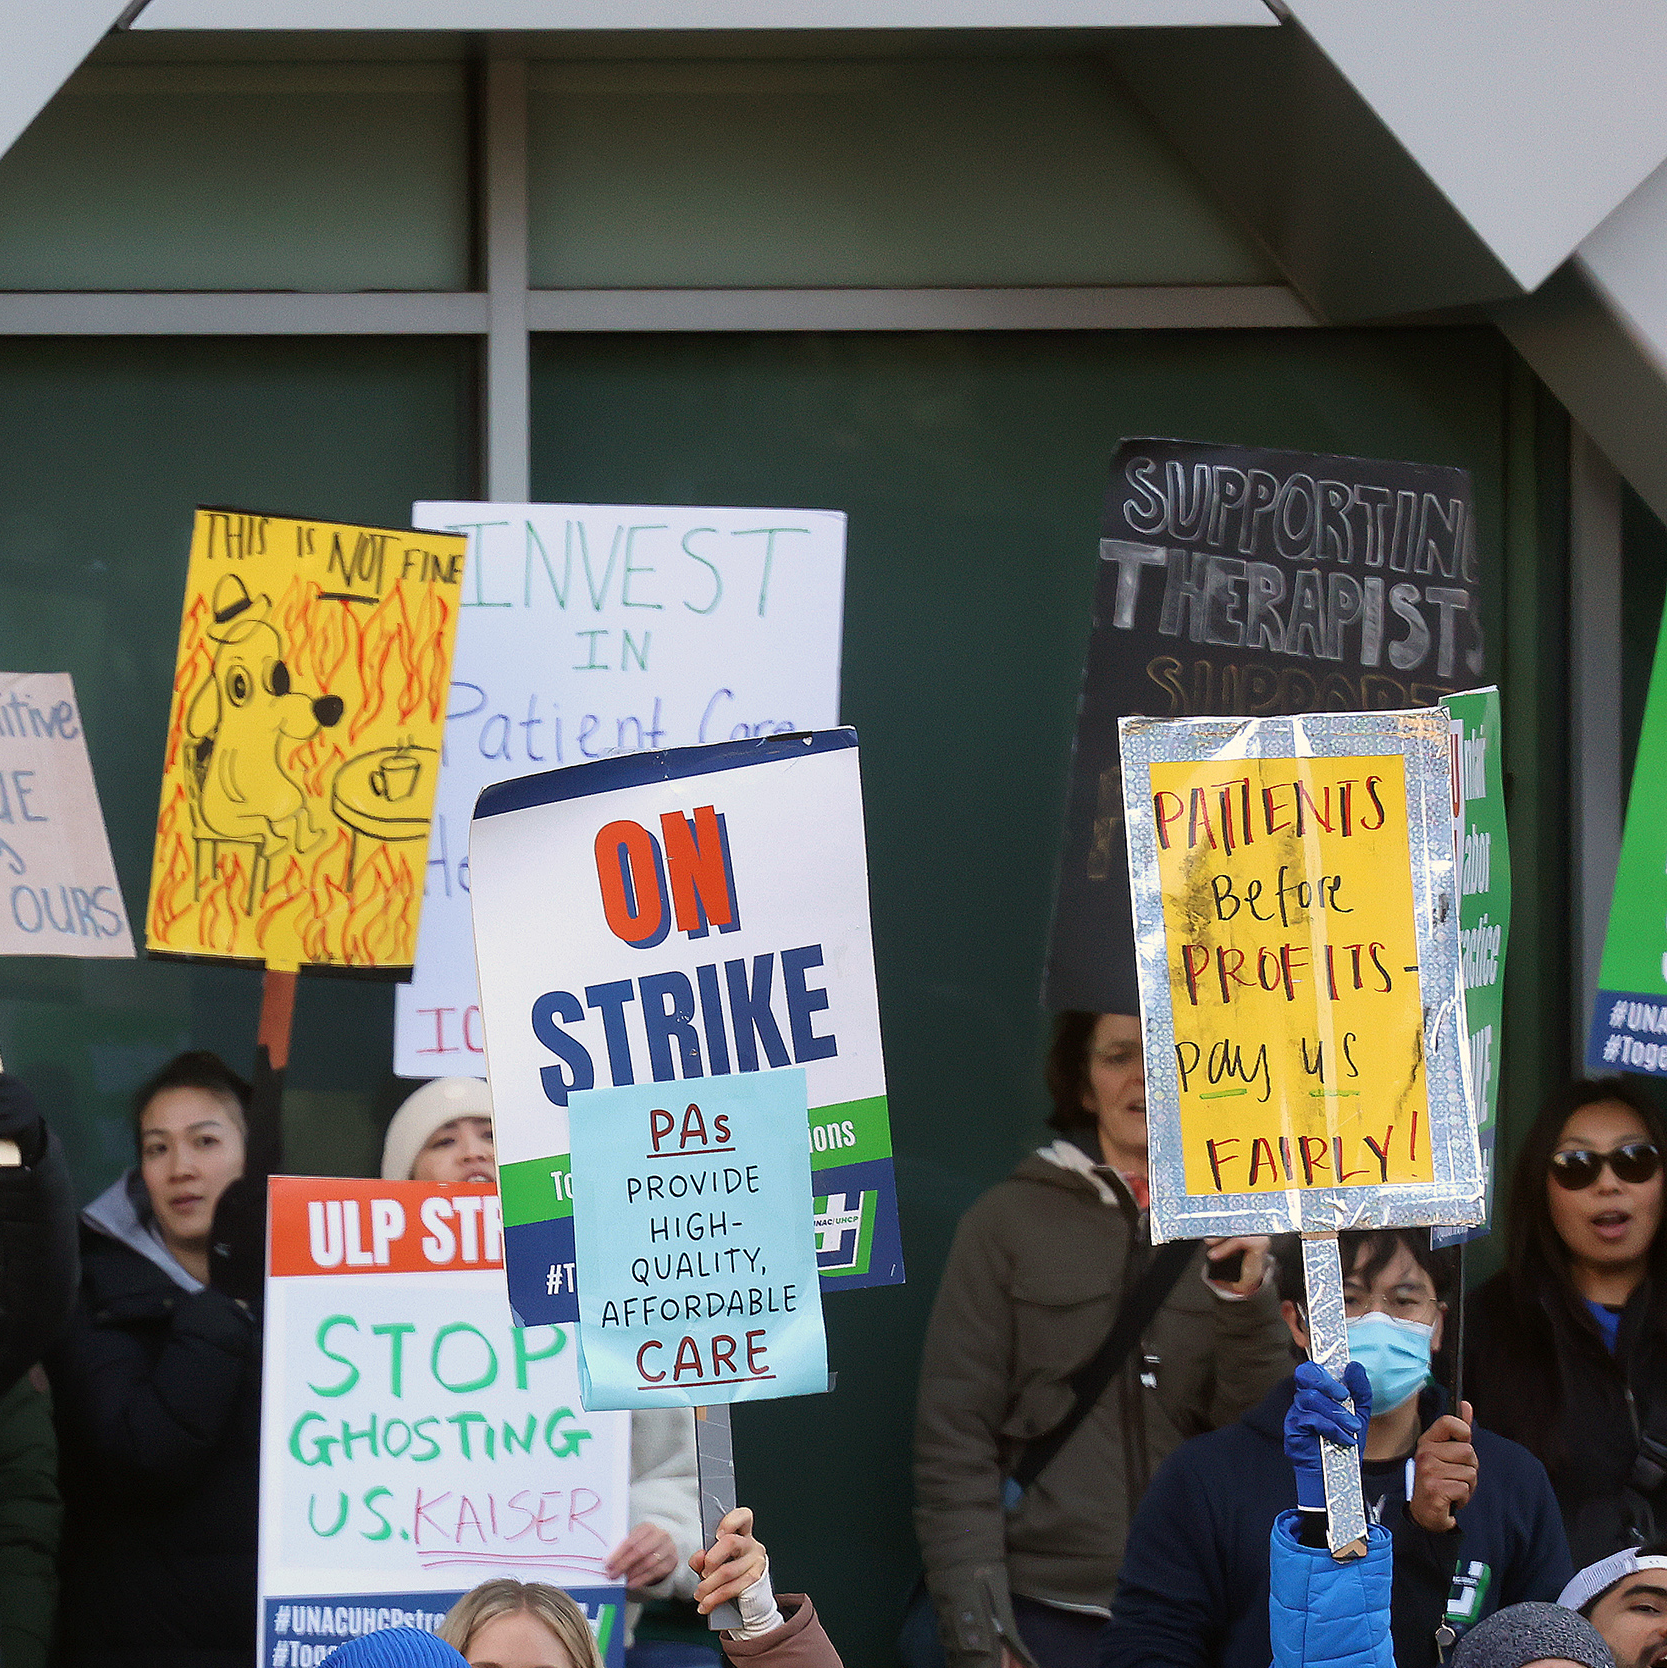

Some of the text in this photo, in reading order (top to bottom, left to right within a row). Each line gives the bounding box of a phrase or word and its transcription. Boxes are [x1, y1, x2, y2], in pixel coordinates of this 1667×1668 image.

[203, 513, 463, 596] THIS IS NOT FINE
[444, 520, 812, 618] INVEST
[573, 628, 652, 673] IN
[1153, 775, 1385, 855] PATIENTS
[594, 805, 739, 948] ON
[1211, 865, 1353, 927] Before
[10, 884, 125, 937] OURS
[531, 944, 836, 1108] STRIKE
[649, 1102, 733, 1149] PAs
[1207, 1112, 1418, 1191] FAIRLY!
[626, 1165, 761, 1202] PROVIDE
[308, 1199, 404, 1267] ULP
[650, 1211, 742, 1243] HIGH-
[632, 1245, 768, 1284] QUALITY,
[601, 1286, 798, 1327] AFFORDABLE
[308, 1314, 567, 1397] STOP
[637, 1328, 772, 1381] CARE
[288, 1408, 592, 1466] GHOSTING
[413, 1486, 608, 1547] KAISER
